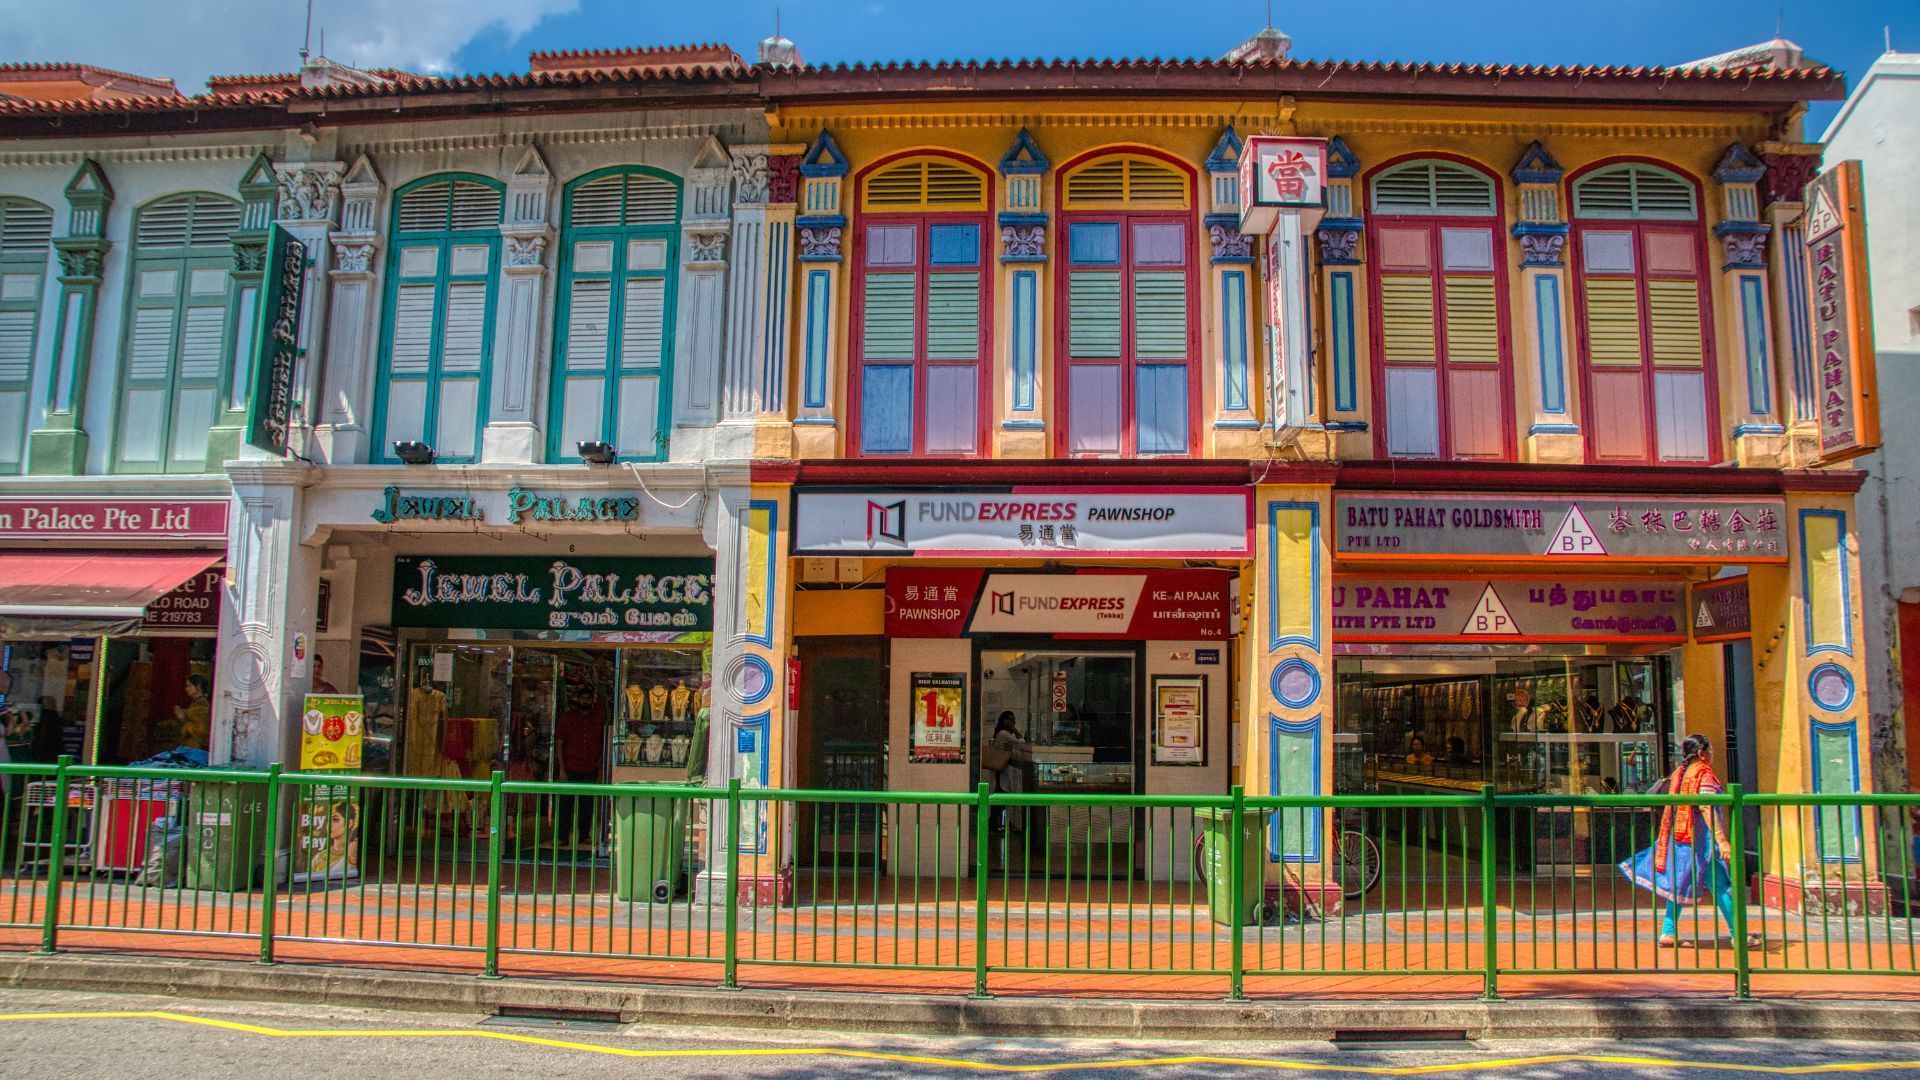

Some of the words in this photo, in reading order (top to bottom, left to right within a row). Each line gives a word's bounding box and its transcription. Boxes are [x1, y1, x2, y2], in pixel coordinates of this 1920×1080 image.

[1267, 149, 1313, 198] 當
[1816, 243, 1838, 321] BATU
[1822, 330, 1845, 428] PAHAT
[370, 486, 484, 523] JEWEL
[507, 487, 640, 523] PALACE
[20, 507, 95, 530] Palace
[102, 508, 142, 530] Pte
[150, 507, 190, 530] Ltd
[1087, 507, 1175, 521] PAWNSHOP
[1347, 507, 1389, 527] BATU
[1395, 508, 1446, 528] PAHAT
[1452, 508, 1542, 529] GOLDSMITH
[1571, 518, 1582, 533] L
[1347, 535, 1370, 547] PTE
[1376, 535, 1401, 547] LTD
[402, 559, 541, 607] JEWEL
[548, 560, 710, 608] PALACE
[905, 585, 958, 601] 易通當
[1187, 591, 1220, 600] PAJAK
[1355, 586, 1449, 609] PAHAT
[174, 598, 209, 608] ROAD
[1486, 597, 1496, 613] L
[161, 612, 202, 623] 219783
[900, 608, 961, 620] PAWNSHOP
[1097, 612, 1124, 620] (Tekka)
[1370, 616, 1400, 629] PTE
[1406, 616, 1436, 629] LTD
